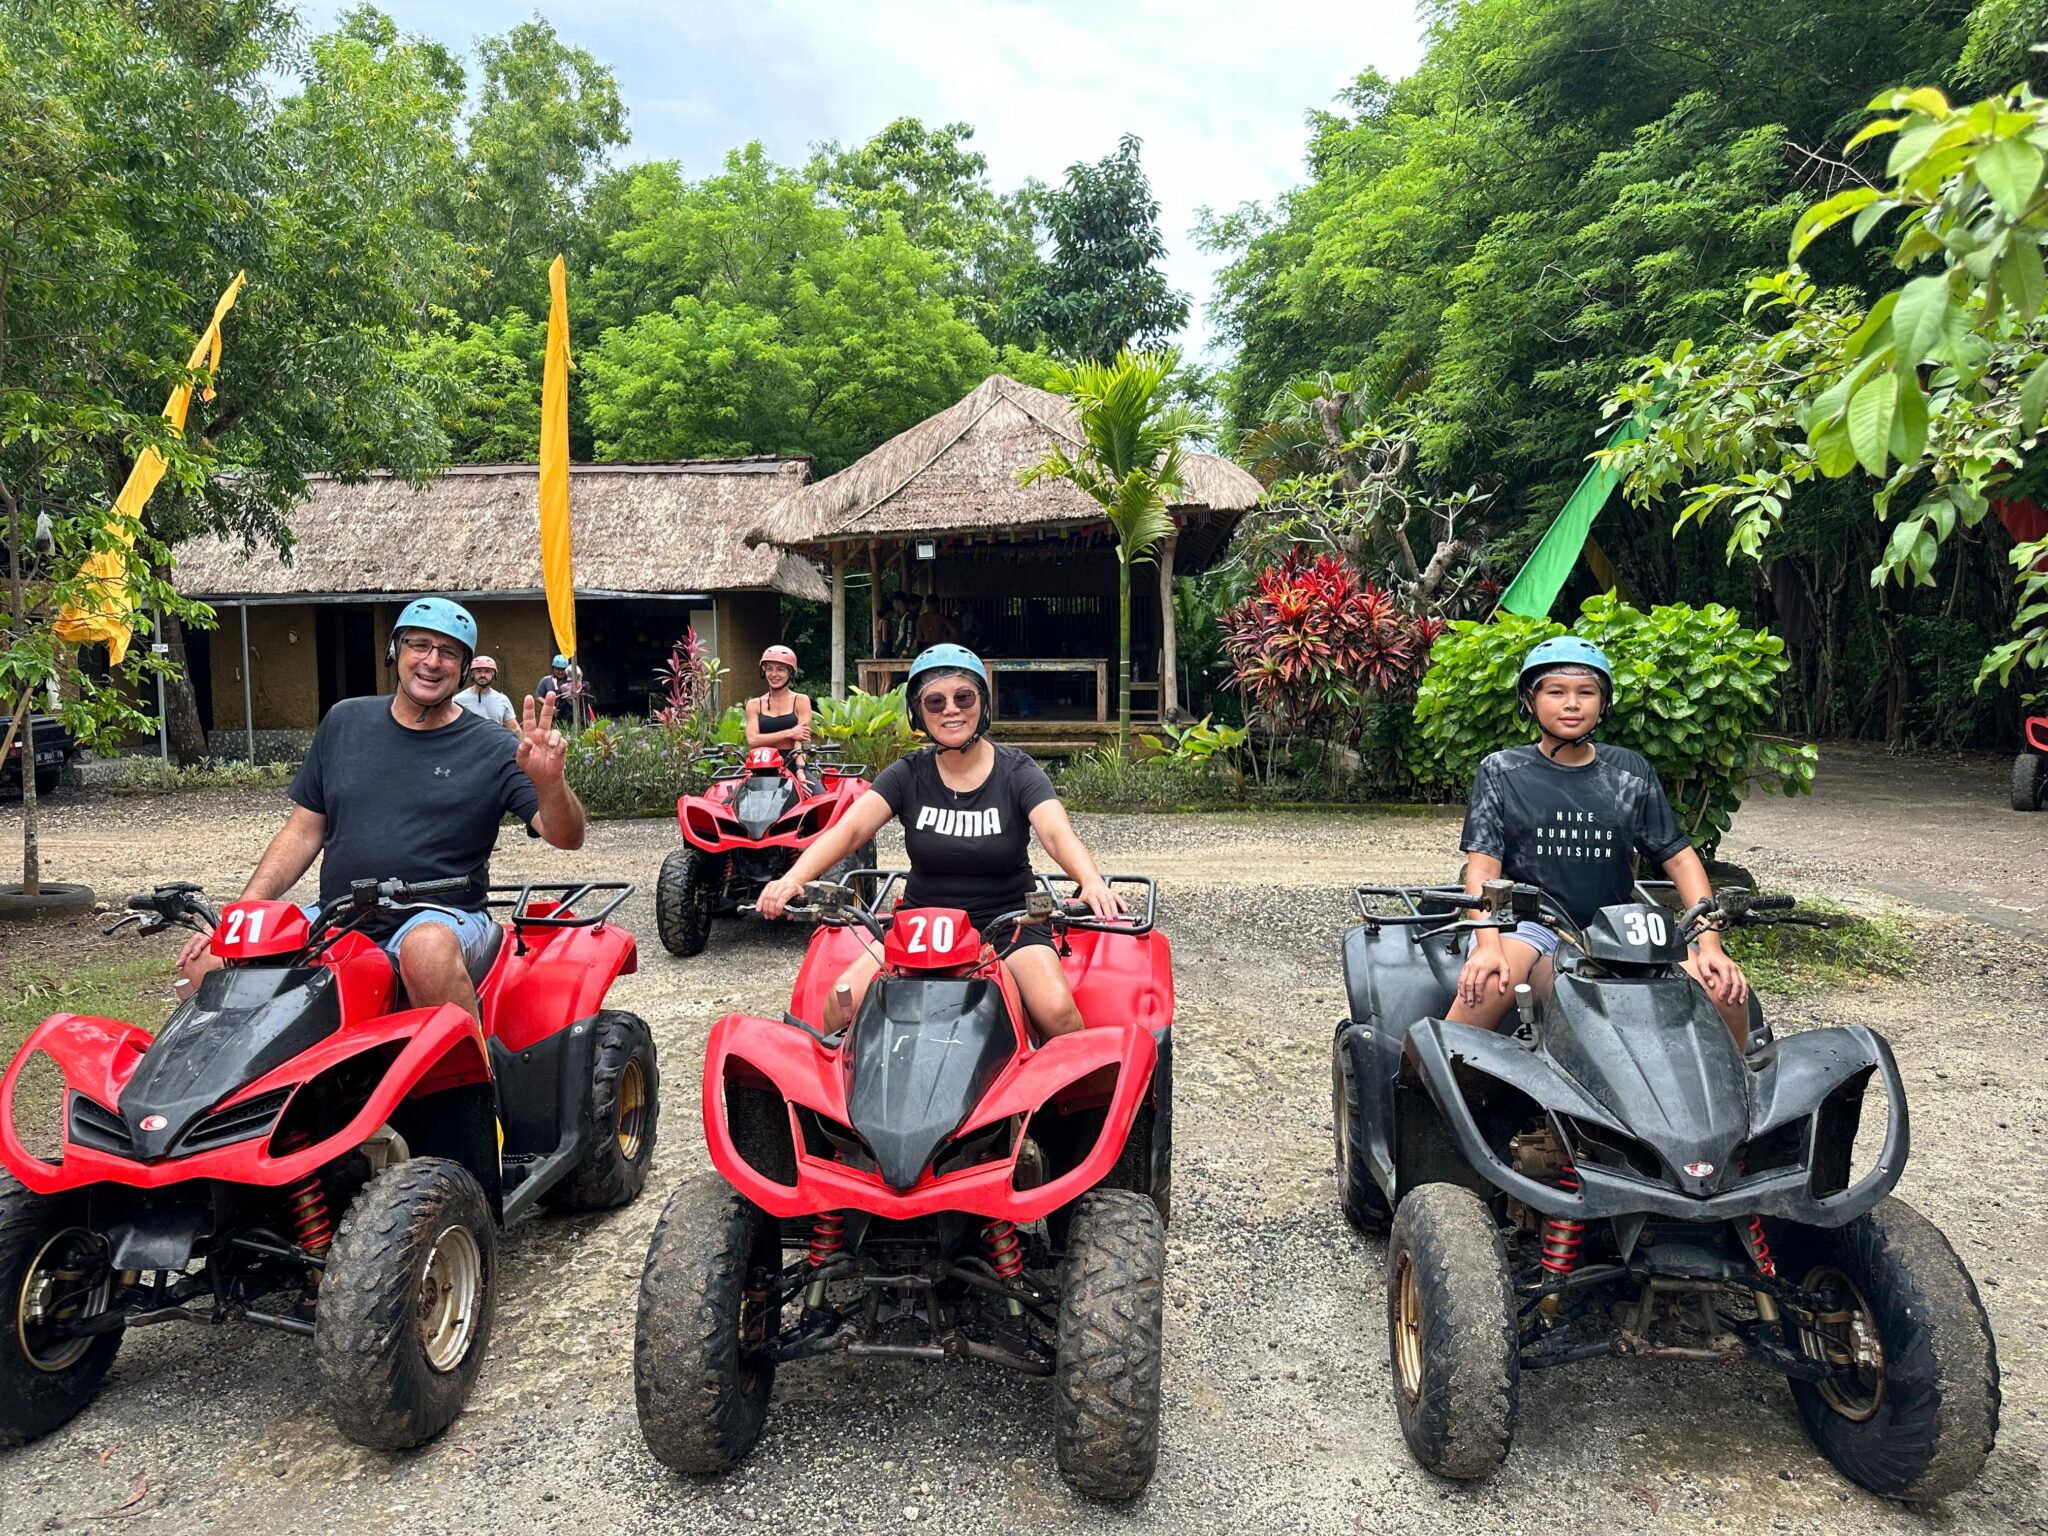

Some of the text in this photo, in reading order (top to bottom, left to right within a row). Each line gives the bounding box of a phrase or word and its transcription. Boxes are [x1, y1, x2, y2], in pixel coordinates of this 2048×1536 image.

[753, 749, 770, 763] 26
[916, 805, 1002, 837] PUMA
[1556, 811, 1594, 822] NIKE
[1537, 827, 1613, 841] RUNNING
[1536, 845, 1611, 858] DIVISION
[224, 909, 265, 945] 21
[907, 915, 954, 954] 20
[1623, 912, 1667, 947] 30
